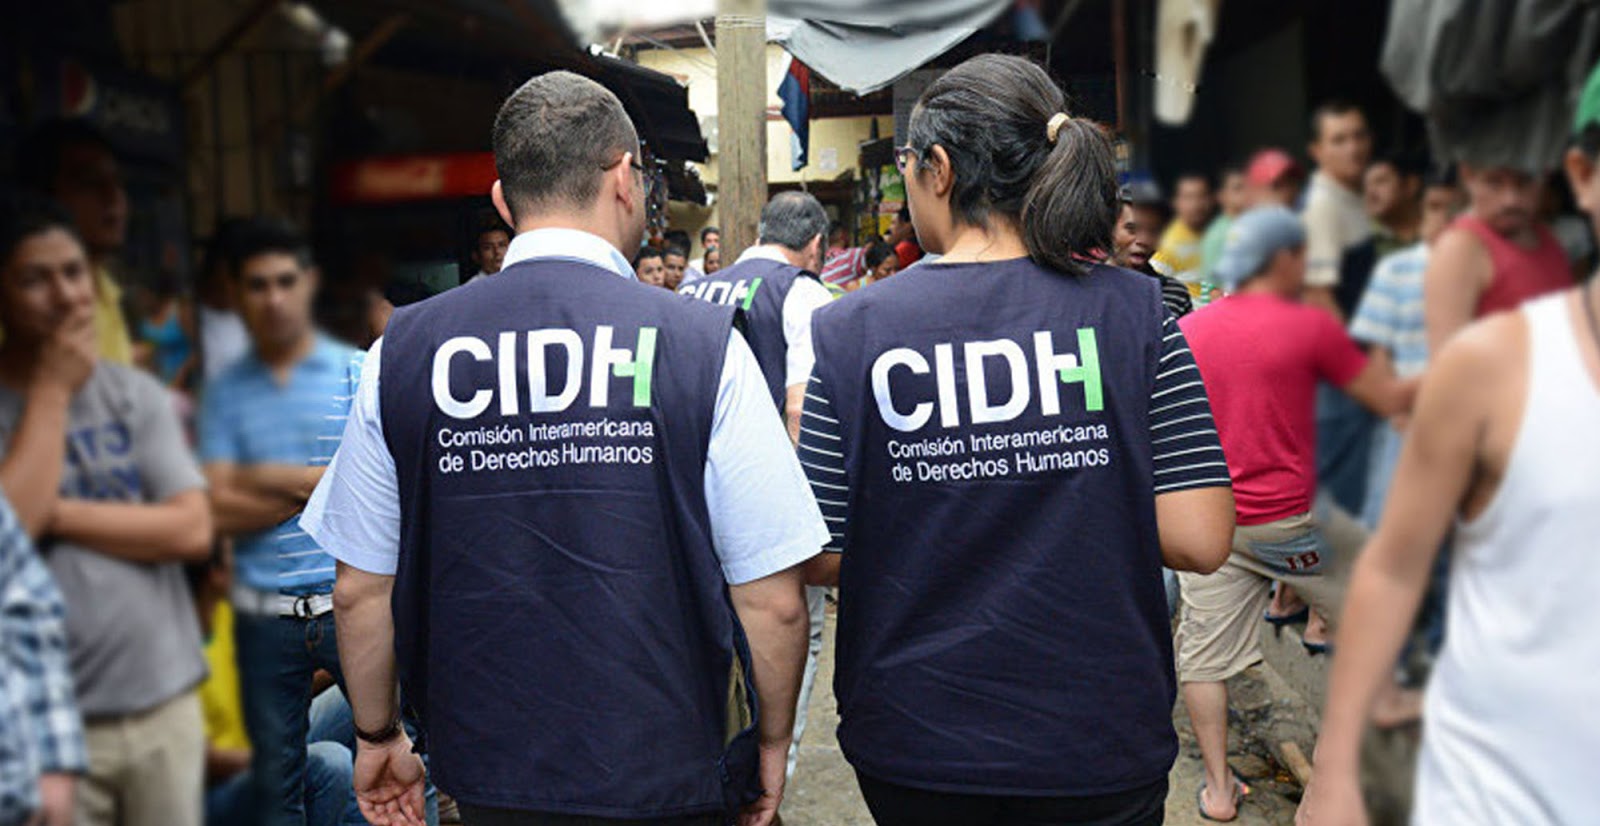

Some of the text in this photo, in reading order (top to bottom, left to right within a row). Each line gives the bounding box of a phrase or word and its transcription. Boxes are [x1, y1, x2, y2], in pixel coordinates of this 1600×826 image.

[432, 325, 657, 419] CIDH
[871, 327, 1104, 432] CIDH
[438, 418, 654, 447] Comisión Interamericana
[888, 424, 1108, 458] Comisión Interamericana
[439, 443, 653, 473] de Derechos Humanos
[892, 448, 1109, 481] de Derechos Humanos
